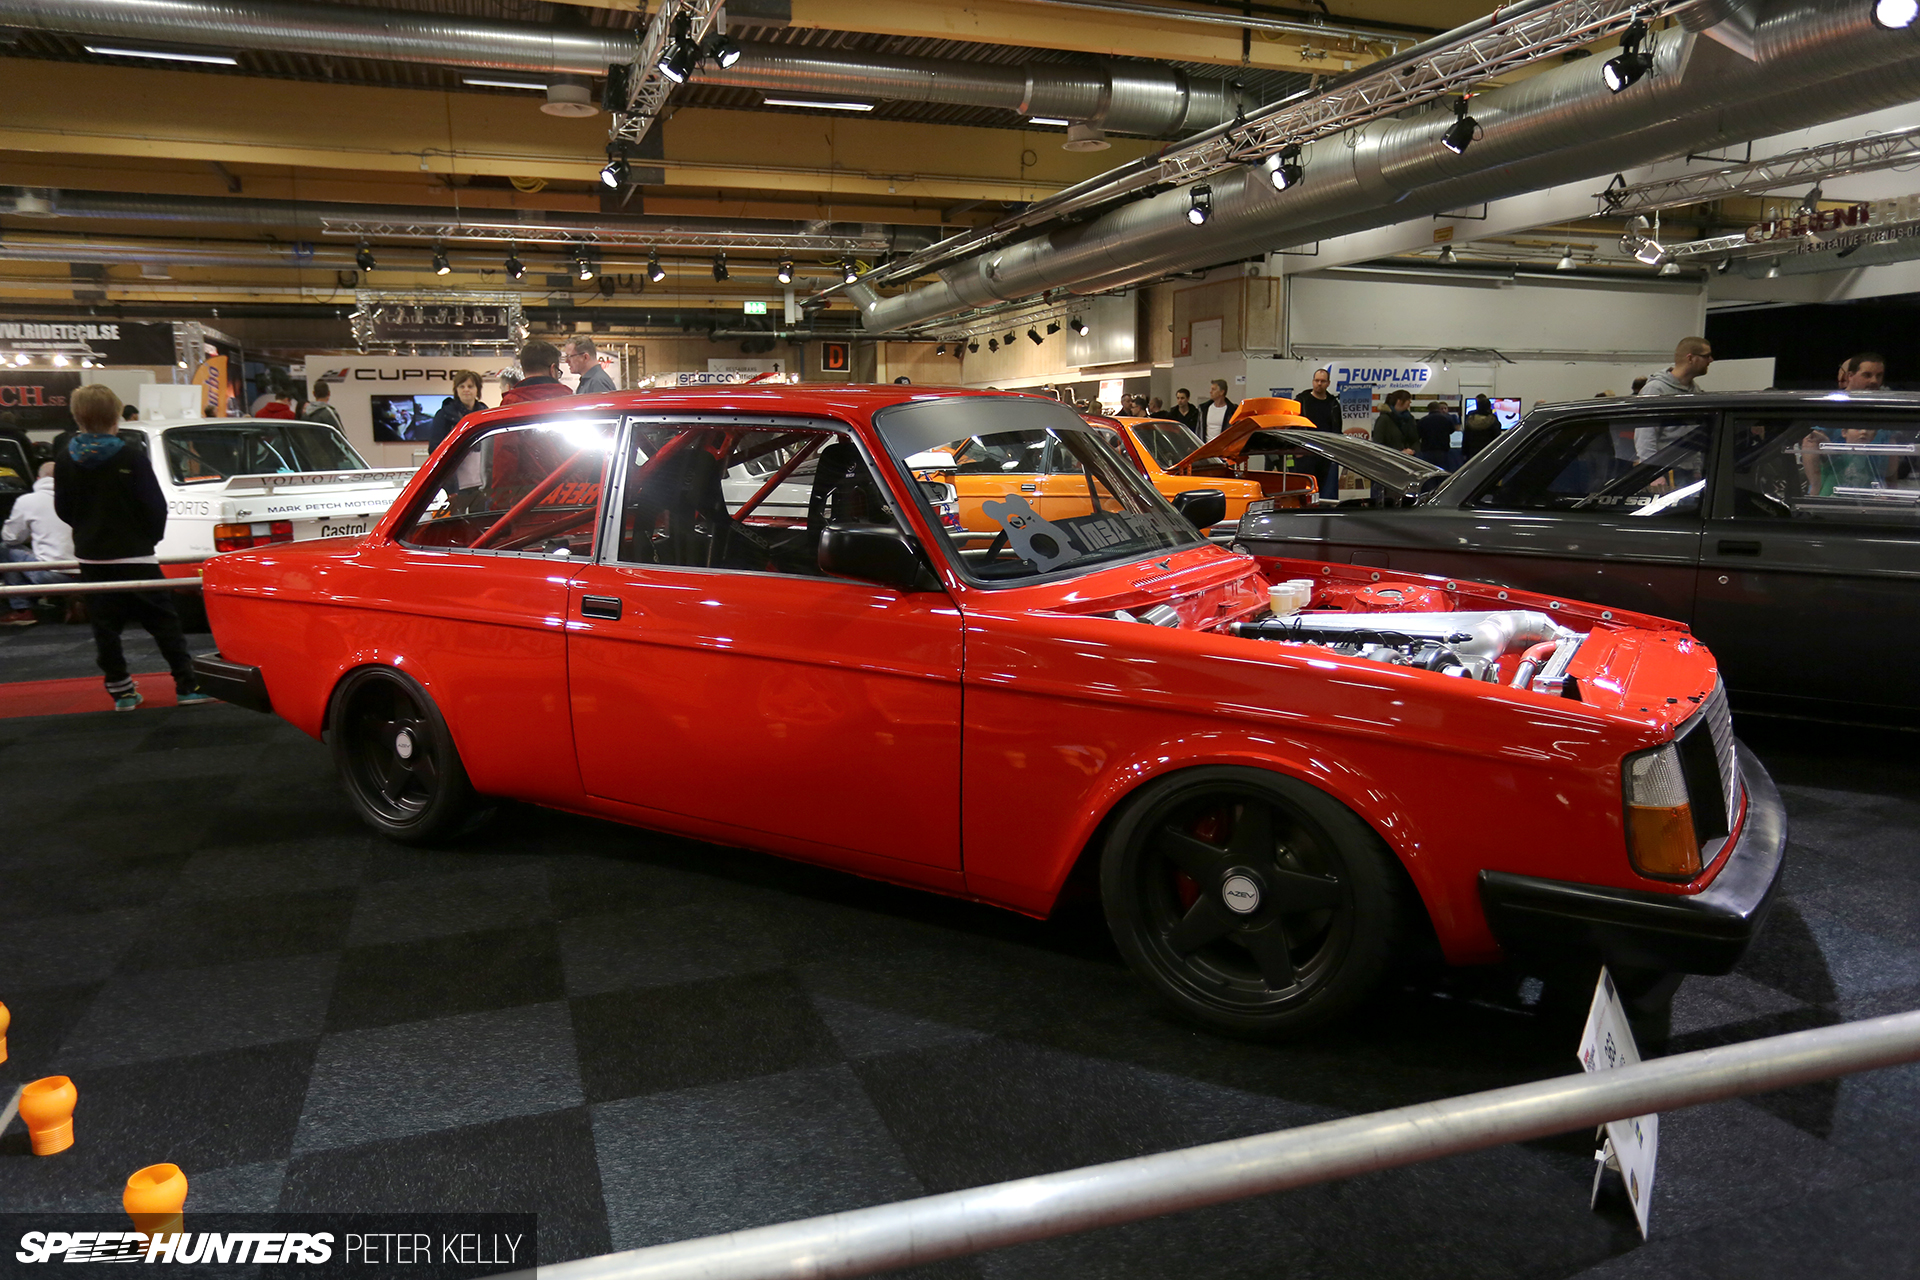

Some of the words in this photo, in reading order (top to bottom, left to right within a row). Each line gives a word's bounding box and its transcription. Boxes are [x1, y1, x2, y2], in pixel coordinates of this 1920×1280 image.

[829, 345, 844, 368] D
[1352, 368, 1429, 382] FUNPLATE
[1342, 404, 1370, 412] EGEN
[261, 475, 324, 487] VOLVO
[351, 471, 413, 483] SPORTS
[267, 504, 302, 514] MARK
[306, 502, 342, 511] PETCH
[321, 522, 367, 538] Castrol
[1227, 890, 1256, 898] AZEV
